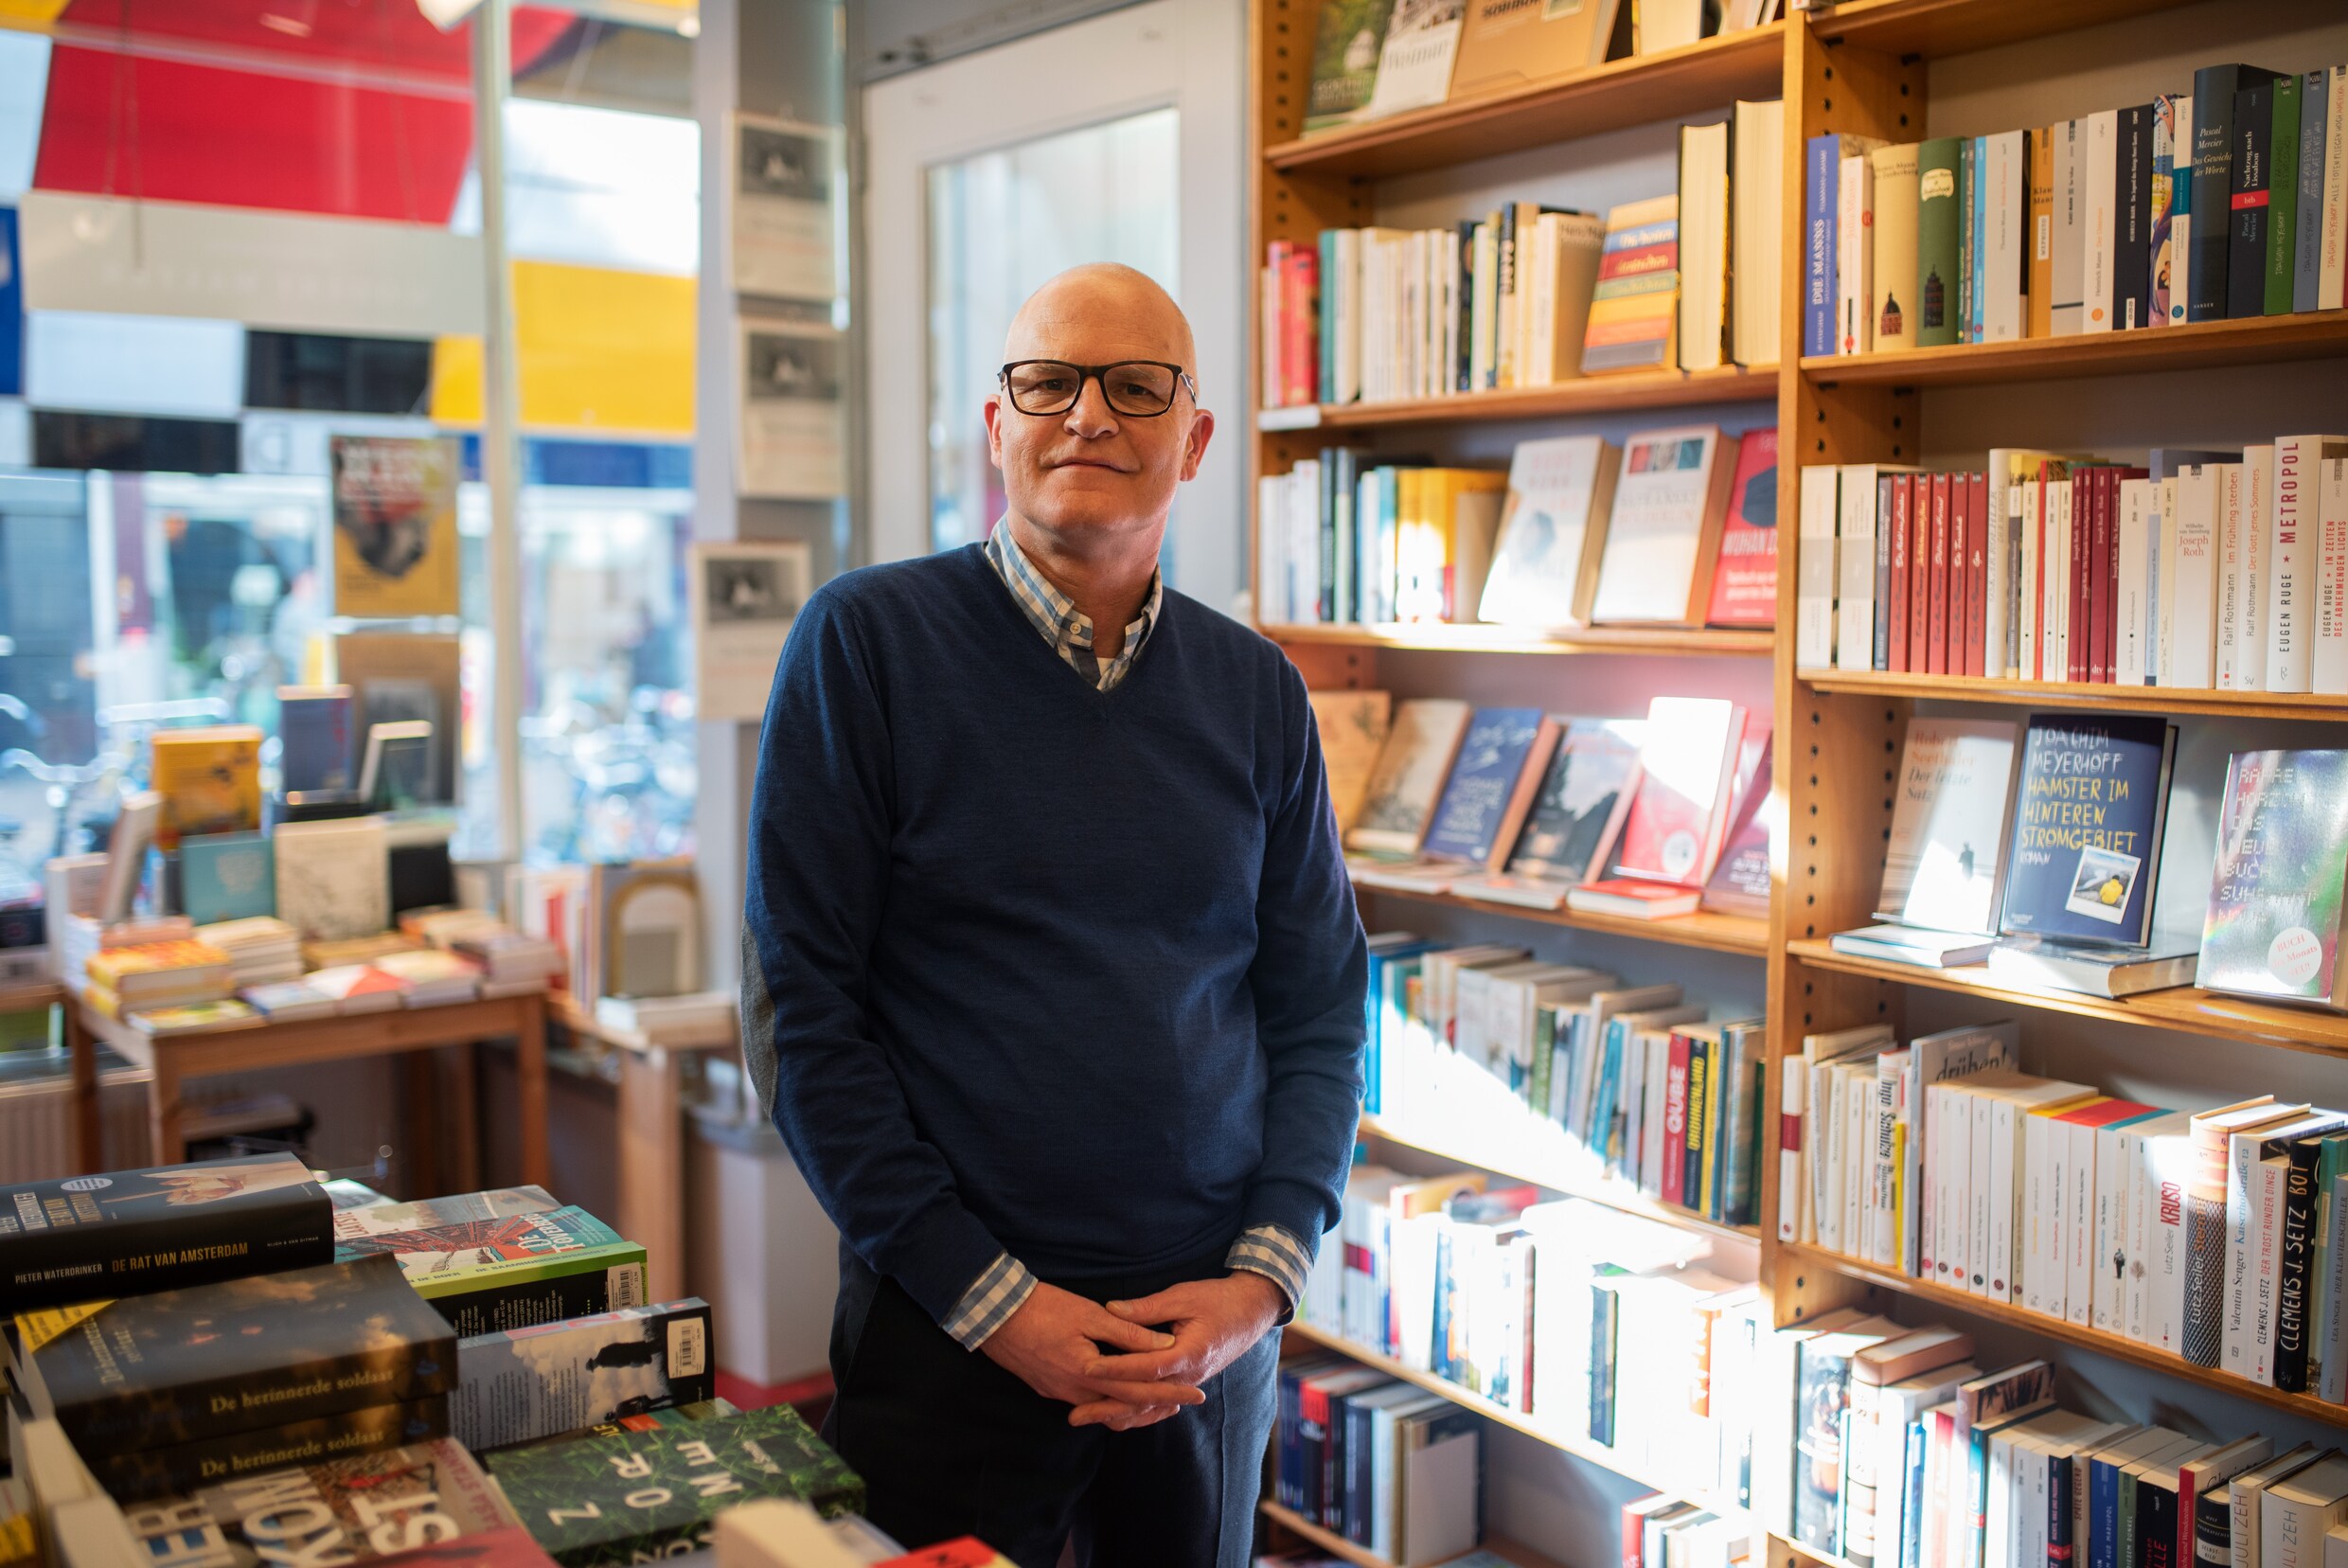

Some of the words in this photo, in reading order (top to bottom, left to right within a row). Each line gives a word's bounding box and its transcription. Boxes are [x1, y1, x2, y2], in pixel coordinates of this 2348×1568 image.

[2335, 84, 2344, 113] AMERIKA
[2198, 124, 2222, 139] Pascal
[2334, 115, 2342, 132] HOCH
[2197, 134, 2224, 151] Mercier
[2245, 131, 2253, 151] nach
[2333, 134, 2341, 159] FLIEGEN
[2192, 154, 2207, 167] Das
[2205, 151, 2233, 165] Gewicht
[2194, 167, 2207, 178] der
[2207, 164, 2228, 177] Worte
[2244, 151, 2253, 187] Nachtzug
[2332, 159, 2340, 181] TOTEN
[2244, 195, 2256, 205] btb
[2249, 212, 2257, 241] Mercier
[2275, 210, 2286, 244] MEYERHOFF
[2304, 207, 2313, 242] MEYERHOFF
[2328, 203, 2339, 237] MEYERHOFF
[1812, 219, 1825, 275] MANNS
[2275, 245, 2285, 276] JOACHIM
[2304, 243, 2312, 274] JOACHIM
[2327, 238, 2336, 268] JOACHIM
[1811, 276, 1825, 305] DIE
[2227, 472, 2238, 508] sterben
[2250, 468, 2261, 508] Sommers
[2278, 441, 2299, 543] METROPOL
[2225, 510, 2239, 549] Frühling
[2249, 509, 2260, 533] jenes
[2179, 535, 2210, 548] Joseph
[2249, 534, 2258, 554] Gott
[2325, 520, 2335, 552] ZEITEN
[2336, 520, 2346, 550] LICHTS
[2182, 545, 2205, 557] Roth
[2225, 551, 2235, 564] Im
[2248, 555, 2257, 570] Der
[2325, 555, 2334, 565] IN
[2223, 573, 2234, 623] Rothmann
[2247, 573, 2256, 617] Rothmann
[2280, 574, 2292, 605] RUGE
[2323, 584, 2333, 606] RUGE
[2335, 555, 2345, 617] ABNEHMENDEN
[2223, 625, 2233, 646] Ralf
[2246, 618, 2255, 637] Ralf
[2279, 613, 2291, 651] EUGEN
[2322, 611, 2332, 636] EUGEN
[2334, 621, 2343, 637] DES
[2091, 663, 2104, 675] dtv
[2035, 727, 2110, 748] JOACHIM
[1910, 768, 1931, 784] Der
[2031, 751, 2123, 775] MEYERHOFF
[1906, 787, 1932, 803] Satz
[2027, 776, 2102, 801] HAMSTER
[2108, 778, 2129, 802] IM
[2024, 801, 2107, 826] HINTEREN
[2019, 826, 2138, 853] STROMGEBIET
[2019, 850, 2051, 866] ROMAN
[2276, 934, 2305, 953] BUCH
[2286, 945, 2319, 963] Monats
[1936, 1044, 2009, 1081] drüben!
[1666, 1064, 1686, 1134] QUBE
[2241, 1148, 2250, 1160] 12
[2264, 1169, 2275, 1195] DINGE
[2289, 1160, 2308, 1195] BOT
[2159, 1182, 2180, 1227] KRUSO
[2233, 1162, 2249, 1245] Kaiserhofstraße
[2263, 1196, 2274, 1230] RUNDER
[2163, 1228, 2175, 1255] Seiler
[2287, 1205, 2306, 1254] SETZ
[2261, 1231, 2272, 1256] TROST
[15, 1270, 43, 1285] PIETER
[44, 1263, 103, 1281] WATERDRINKER
[112, 1258, 127, 1273] DE
[130, 1254, 151, 1271] RAT
[154, 1250, 177, 1267] VAN
[180, 1241, 248, 1265] AMSTERDAM
[2163, 1255, 2174, 1275] Lutz
[2192, 1255, 2204, 1292] Seiler
[2232, 1248, 2248, 1287] Senger
[2261, 1258, 2271, 1275] DER
[2286, 1259, 2303, 1274] J.
[2260, 1278, 2270, 1300] SETZ
[2333, 1274, 2342, 1293] DER
[2190, 1295, 2202, 1325] Lutz
[2230, 1289, 2244, 1332] Valentin
[2280, 1277, 2303, 1351] CLEMENS
[2332, 1299, 2341, 1327] SINGER
[2257, 1309, 2269, 1345] CLEMENS
[2331, 1327, 2339, 1343] LEA
[210, 1395, 237, 1416] De
[242, 1377, 332, 1409] herinnerde
[336, 1367, 394, 1393] soldaat
[201, 1458, 226, 1479] De
[233, 1442, 323, 1471] herinnerde
[328, 1430, 384, 1456] soldaat
[2232, 1494, 2248, 1531] ZEH
[2126, 1514, 2134, 1541] DUNKEL
[2283, 1509, 2298, 1545] ZEH
[2233, 1532, 2249, 1568] JULI
